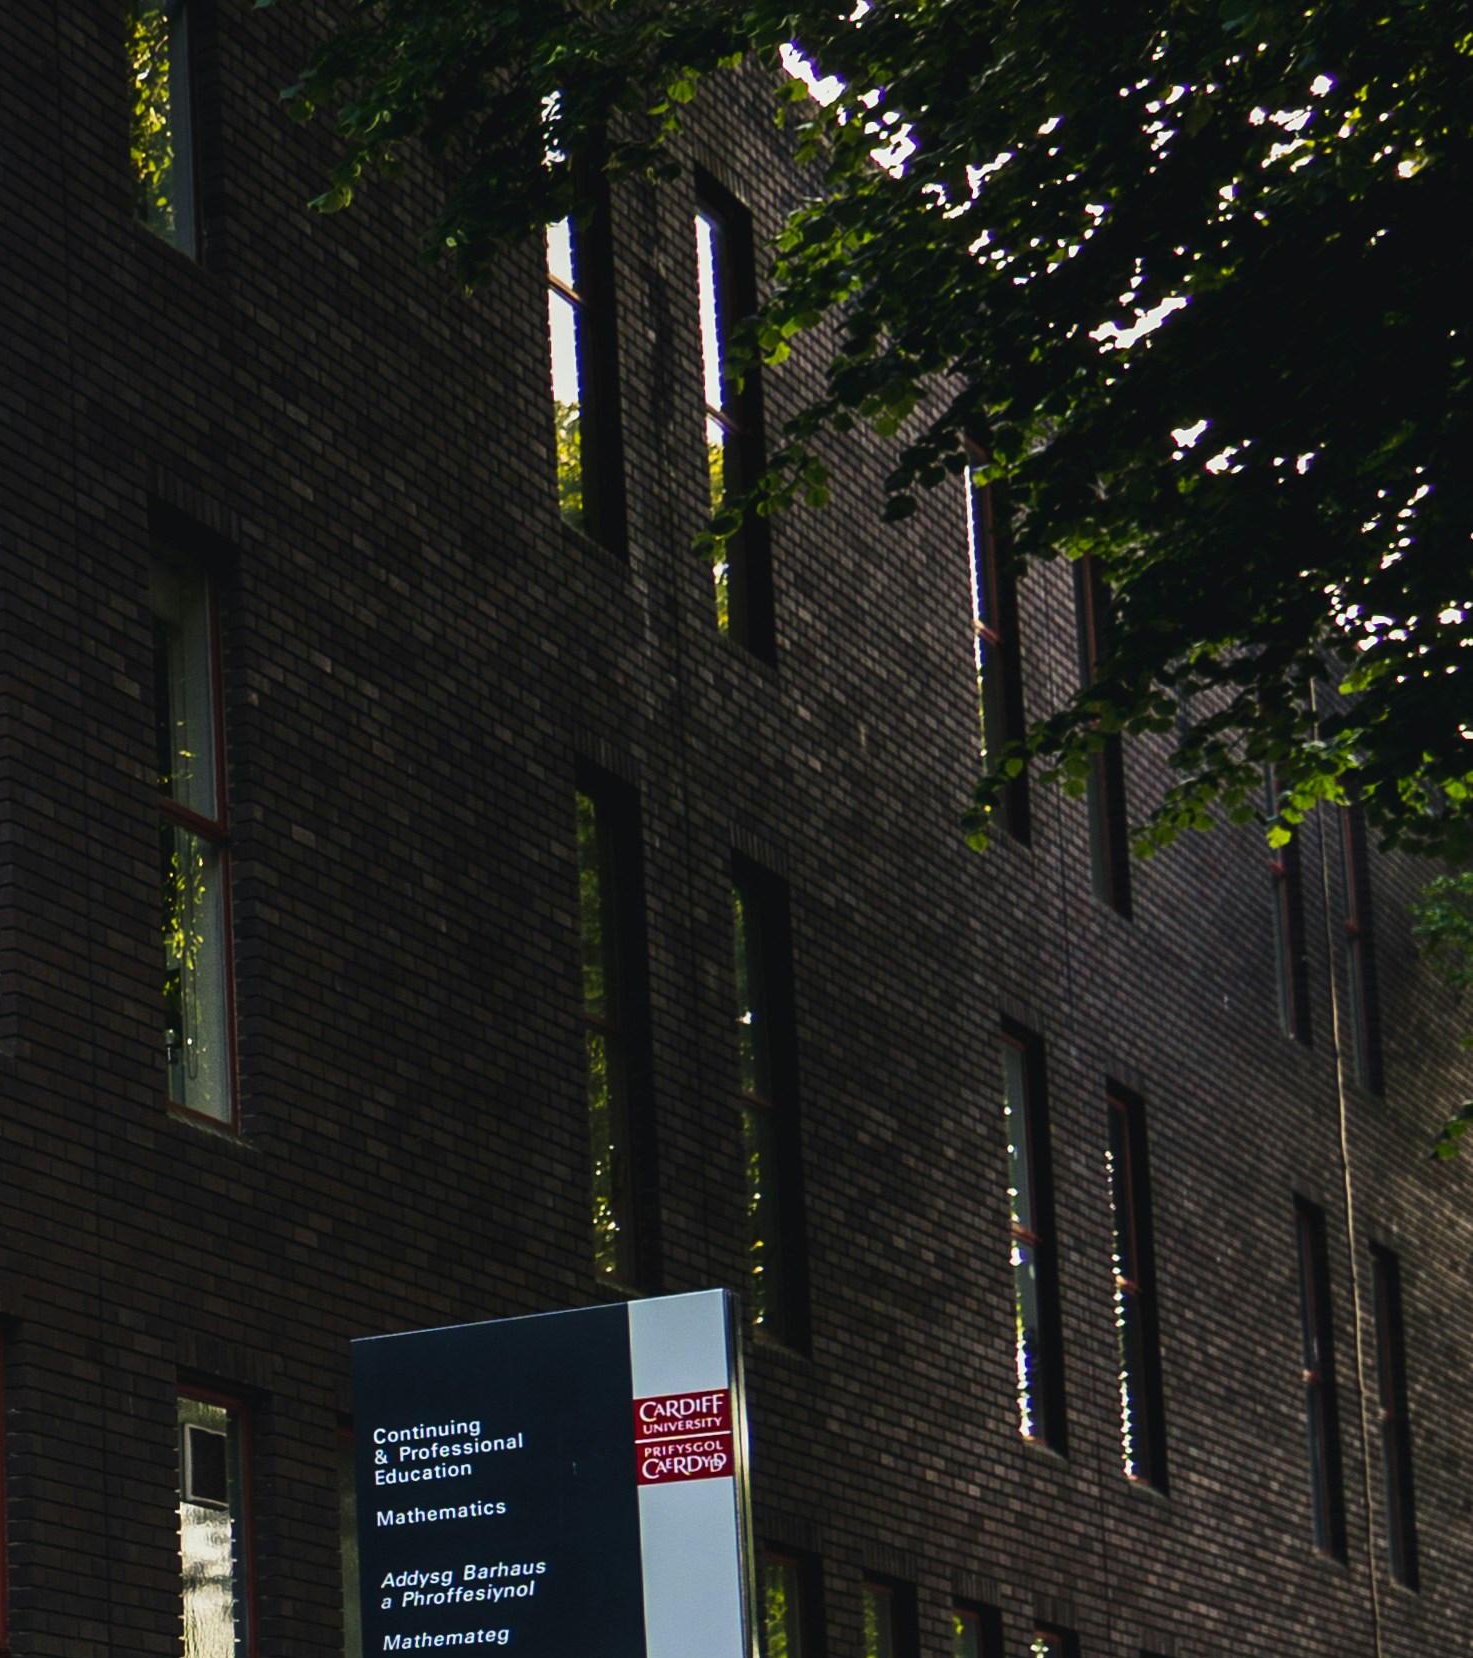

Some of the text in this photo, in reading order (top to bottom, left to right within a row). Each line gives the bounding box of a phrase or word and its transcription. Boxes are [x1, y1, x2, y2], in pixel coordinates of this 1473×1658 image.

[638, 1394, 725, 1423] CARDIFF
[372, 1418, 482, 1445] Continuing
[642, 1417, 723, 1436] UNIVERSITY
[373, 1433, 524, 1466] & Professional
[643, 1440, 724, 1459] PRIFYSGOL
[374, 1461, 473, 1486] Education
[641, 1452, 728, 1480] CAERDYDD
[376, 1499, 507, 1528] Mathematics
[380, 1559, 547, 1590] Addysg Barhaus
[381, 1581, 536, 1611] a Phroffesiynol
[382, 1627, 510, 1652] Mathemateg
